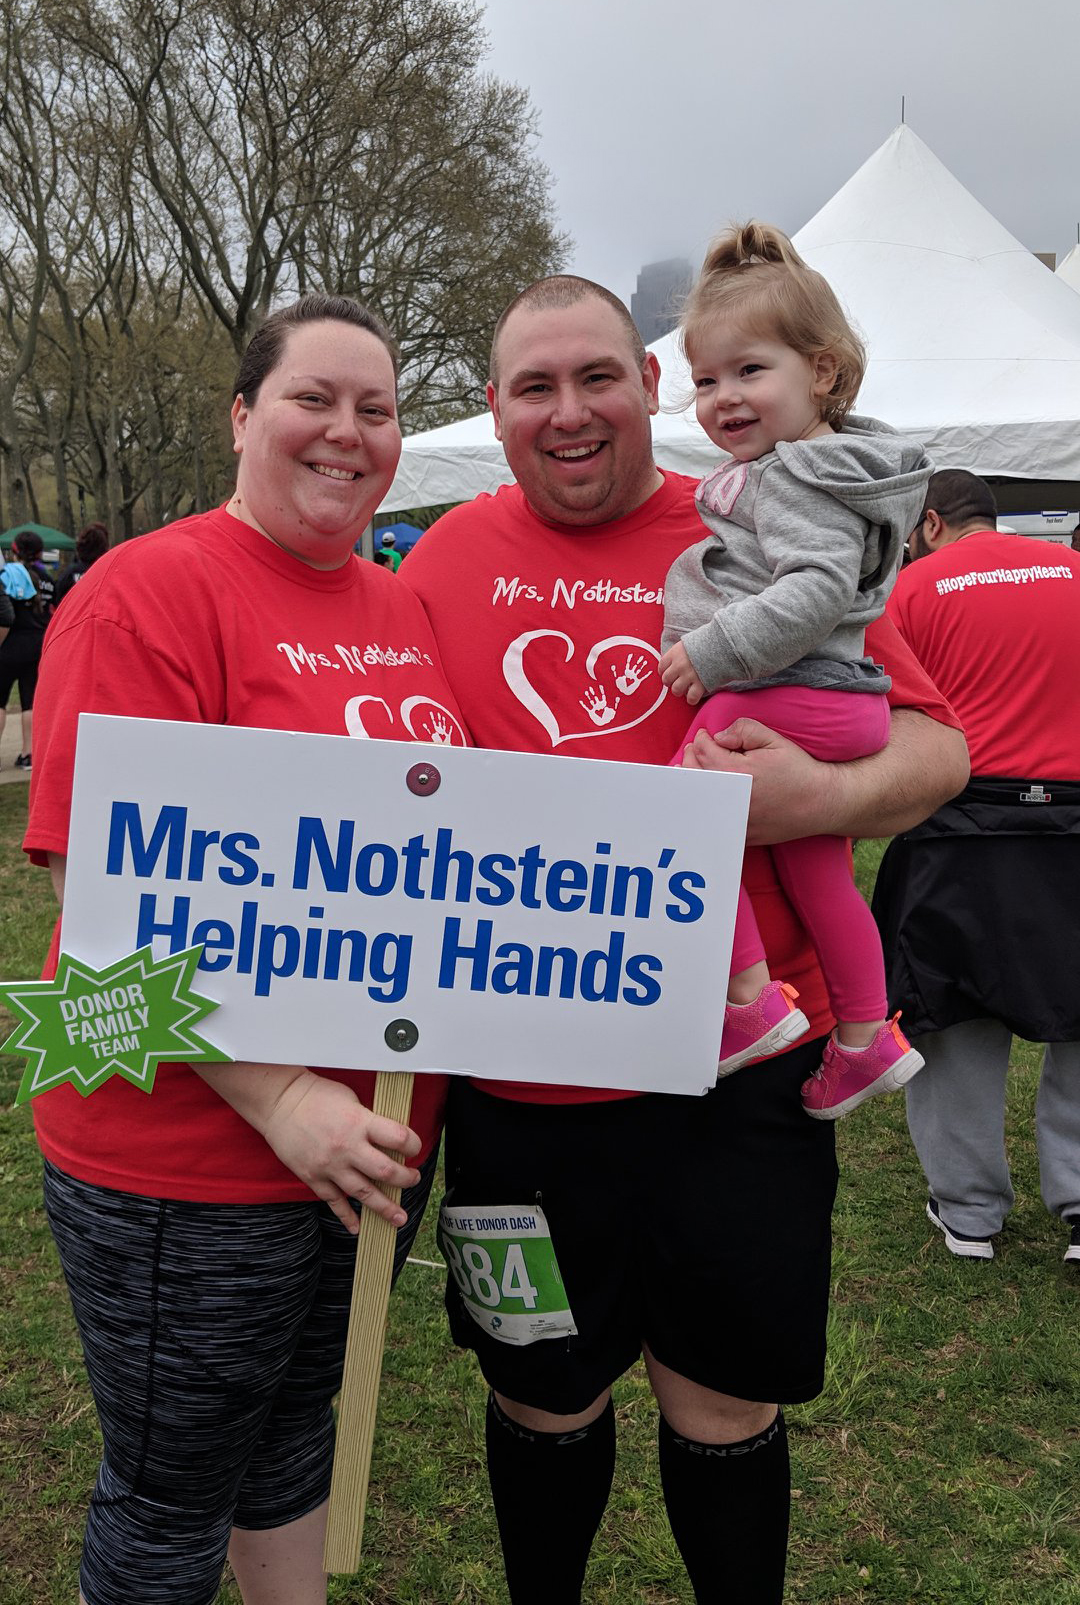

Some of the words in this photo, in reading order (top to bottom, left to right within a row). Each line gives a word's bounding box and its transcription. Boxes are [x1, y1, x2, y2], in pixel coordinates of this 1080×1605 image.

[493, 576, 544, 606] Mrs.
[550, 578, 665, 610] Nothstei
[936, 565, 1073, 596] #HopeFourHappyHearts
[276, 642, 341, 675] Mrs.
[106, 801, 275, 888] Mrs.
[292, 816, 706, 923] Nothstein's
[135, 893, 413, 1004] Helping
[438, 916, 663, 1006] Hands
[59, 983, 146, 1022] DONOR
[64, 1005, 150, 1046] FAMILY
[89, 1034, 141, 1059] TEAM
[454, 1218, 475, 1231] LIFE
[476, 1218, 509, 1231] DONOR
[509, 1216, 537, 1230] DASH
